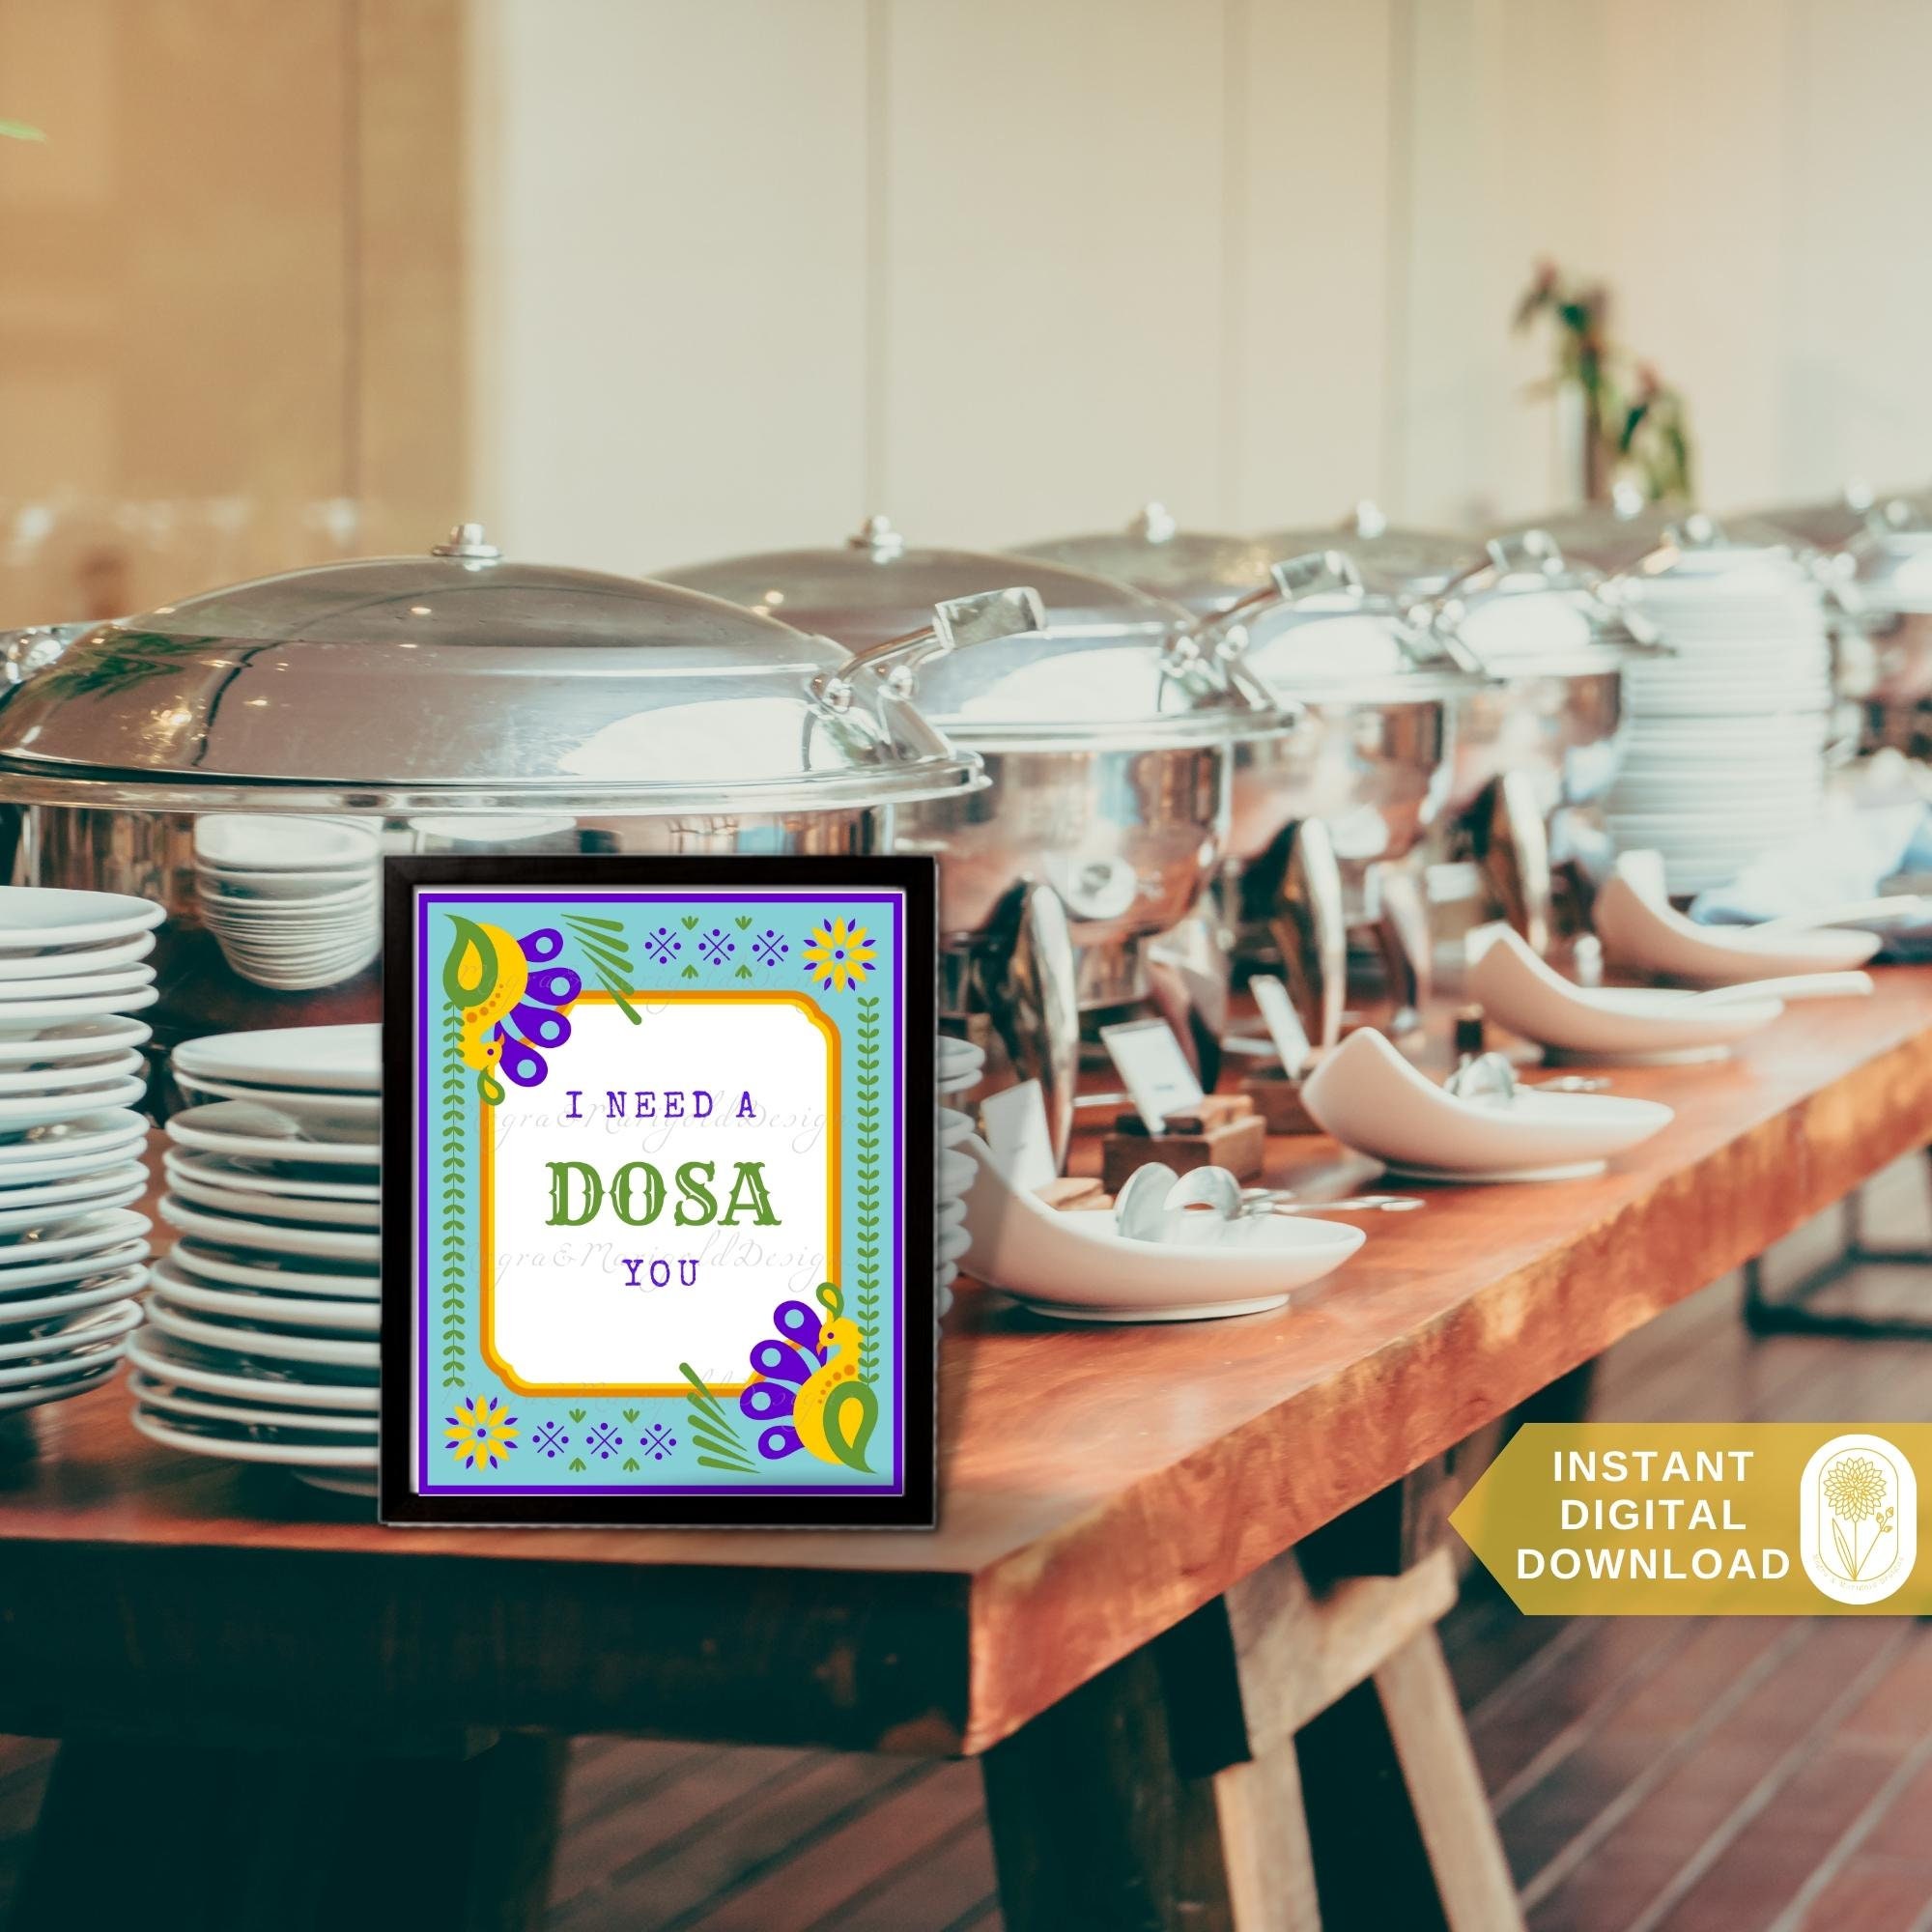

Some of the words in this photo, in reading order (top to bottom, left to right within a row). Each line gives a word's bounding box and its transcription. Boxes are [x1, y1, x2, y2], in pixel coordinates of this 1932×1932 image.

[565, 1091, 582, 1118] I
[607, 1091, 713, 1118] NEED
[736, 1091, 756, 1119] A
[546, 1161, 782, 1227] DOSA
[622, 1259, 699, 1287] YOU
